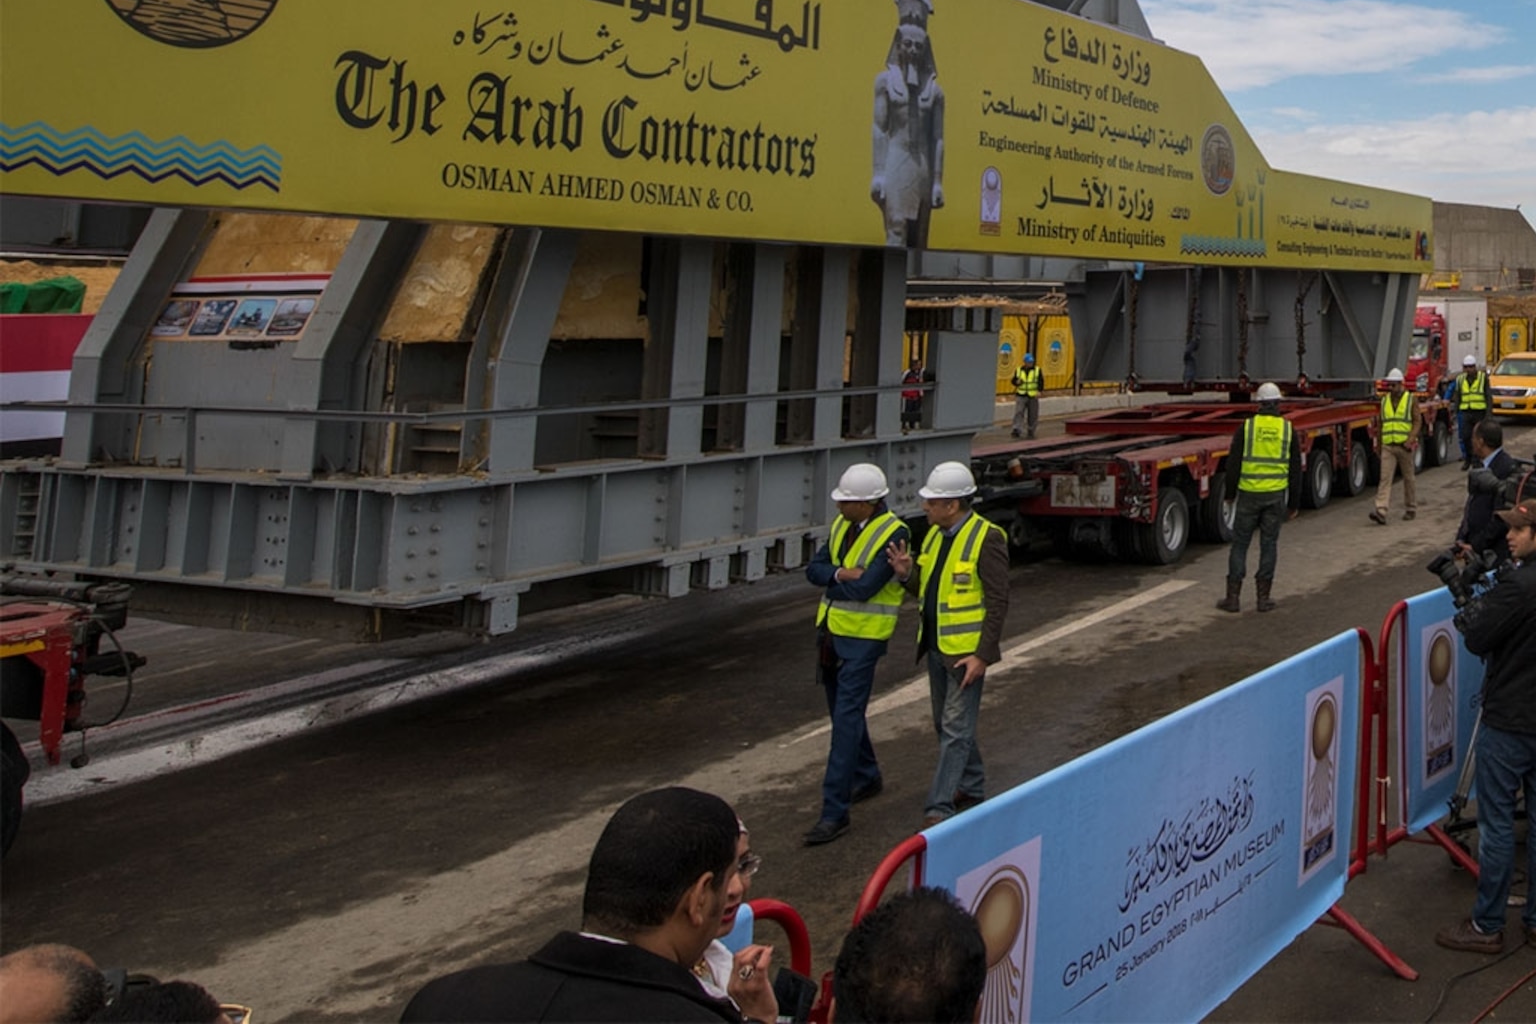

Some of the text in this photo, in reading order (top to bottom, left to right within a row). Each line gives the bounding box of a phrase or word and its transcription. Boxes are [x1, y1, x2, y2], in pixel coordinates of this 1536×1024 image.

[528, 24, 625, 65] عثمان
[1043, 27, 1151, 87] وزارة الدفاع
[686, 53, 762, 91] عثمان
[1032, 66, 1159, 114] Ministry of Defence
[335, 50, 818, 178] The Arab Contractors
[982, 90, 1047, 123] المسلحة
[1052, 105, 1095, 135] للقوات
[979, 131, 1052, 159] Engineering
[1054, 147, 1104, 169] Authority
[1107, 154, 1117, 168] of
[1119, 157, 1134, 171] the
[1136, 159, 1166, 177] Armed
[442, 162, 754, 213] OSMAN AHMED OSMAN & CO.
[1118, 186, 1154, 221] وزارة
[1017, 217, 1079, 244] Ministry
[1082, 223, 1095, 242] of
[1099, 224, 1166, 248] Antiquities
[1062, 923, 1136, 988] GRAND
[1139, 867, 1221, 937] EGYPTIAN
[1223, 819, 1285, 878] MUSEUM
[1115, 962, 1129, 982] 25
[1130, 937, 1165, 971] January
